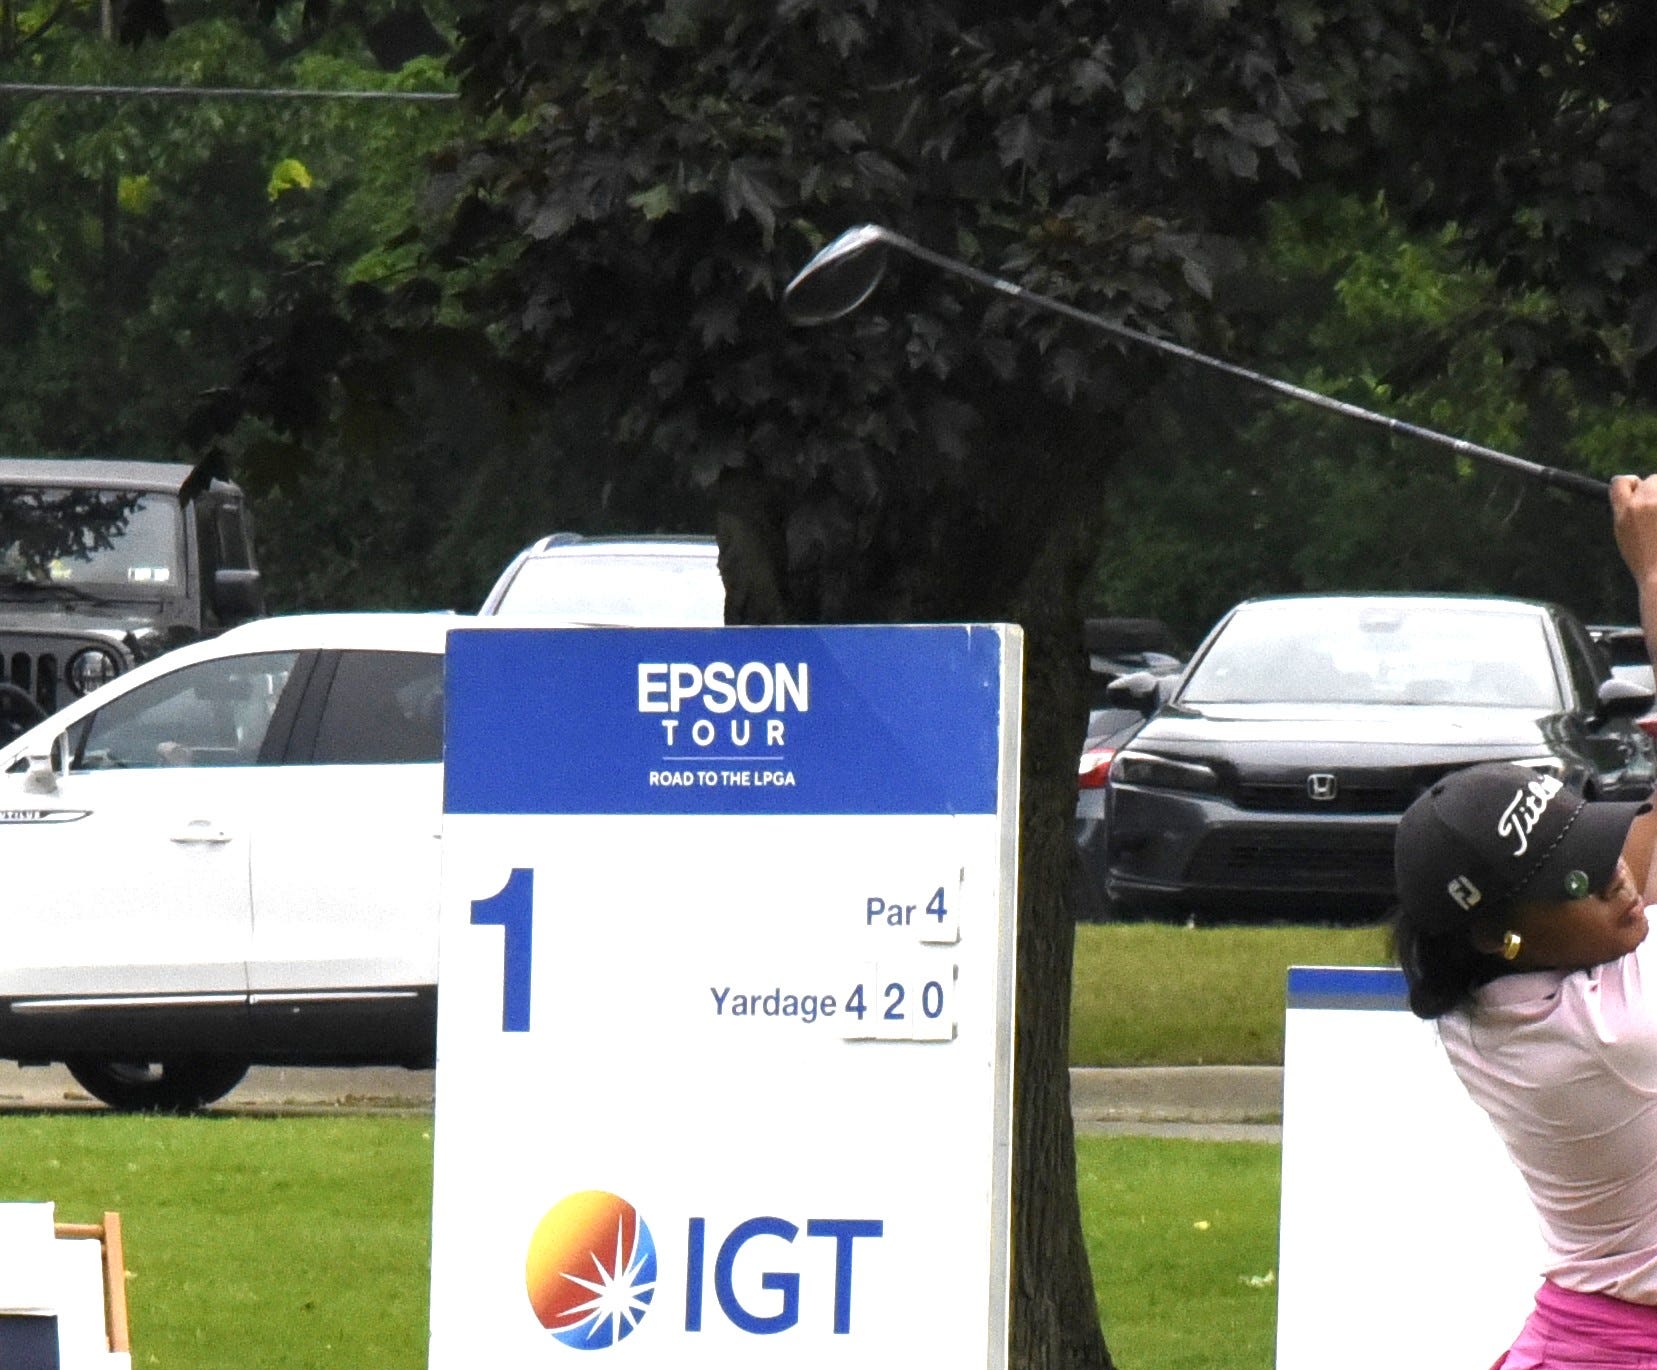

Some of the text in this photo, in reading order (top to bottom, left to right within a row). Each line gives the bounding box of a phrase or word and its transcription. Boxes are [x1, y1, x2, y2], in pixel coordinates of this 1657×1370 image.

[638, 662, 808, 713] EPSON
[662, 719, 784, 747] TOUR
[649, 771, 796, 787] ROAD TO THE LPGA
[866, 887, 948, 926] Par 4
[470, 868, 534, 1032] 1
[710, 987, 837, 1024] Yardage
[685, 1215, 884, 1335] IGT
